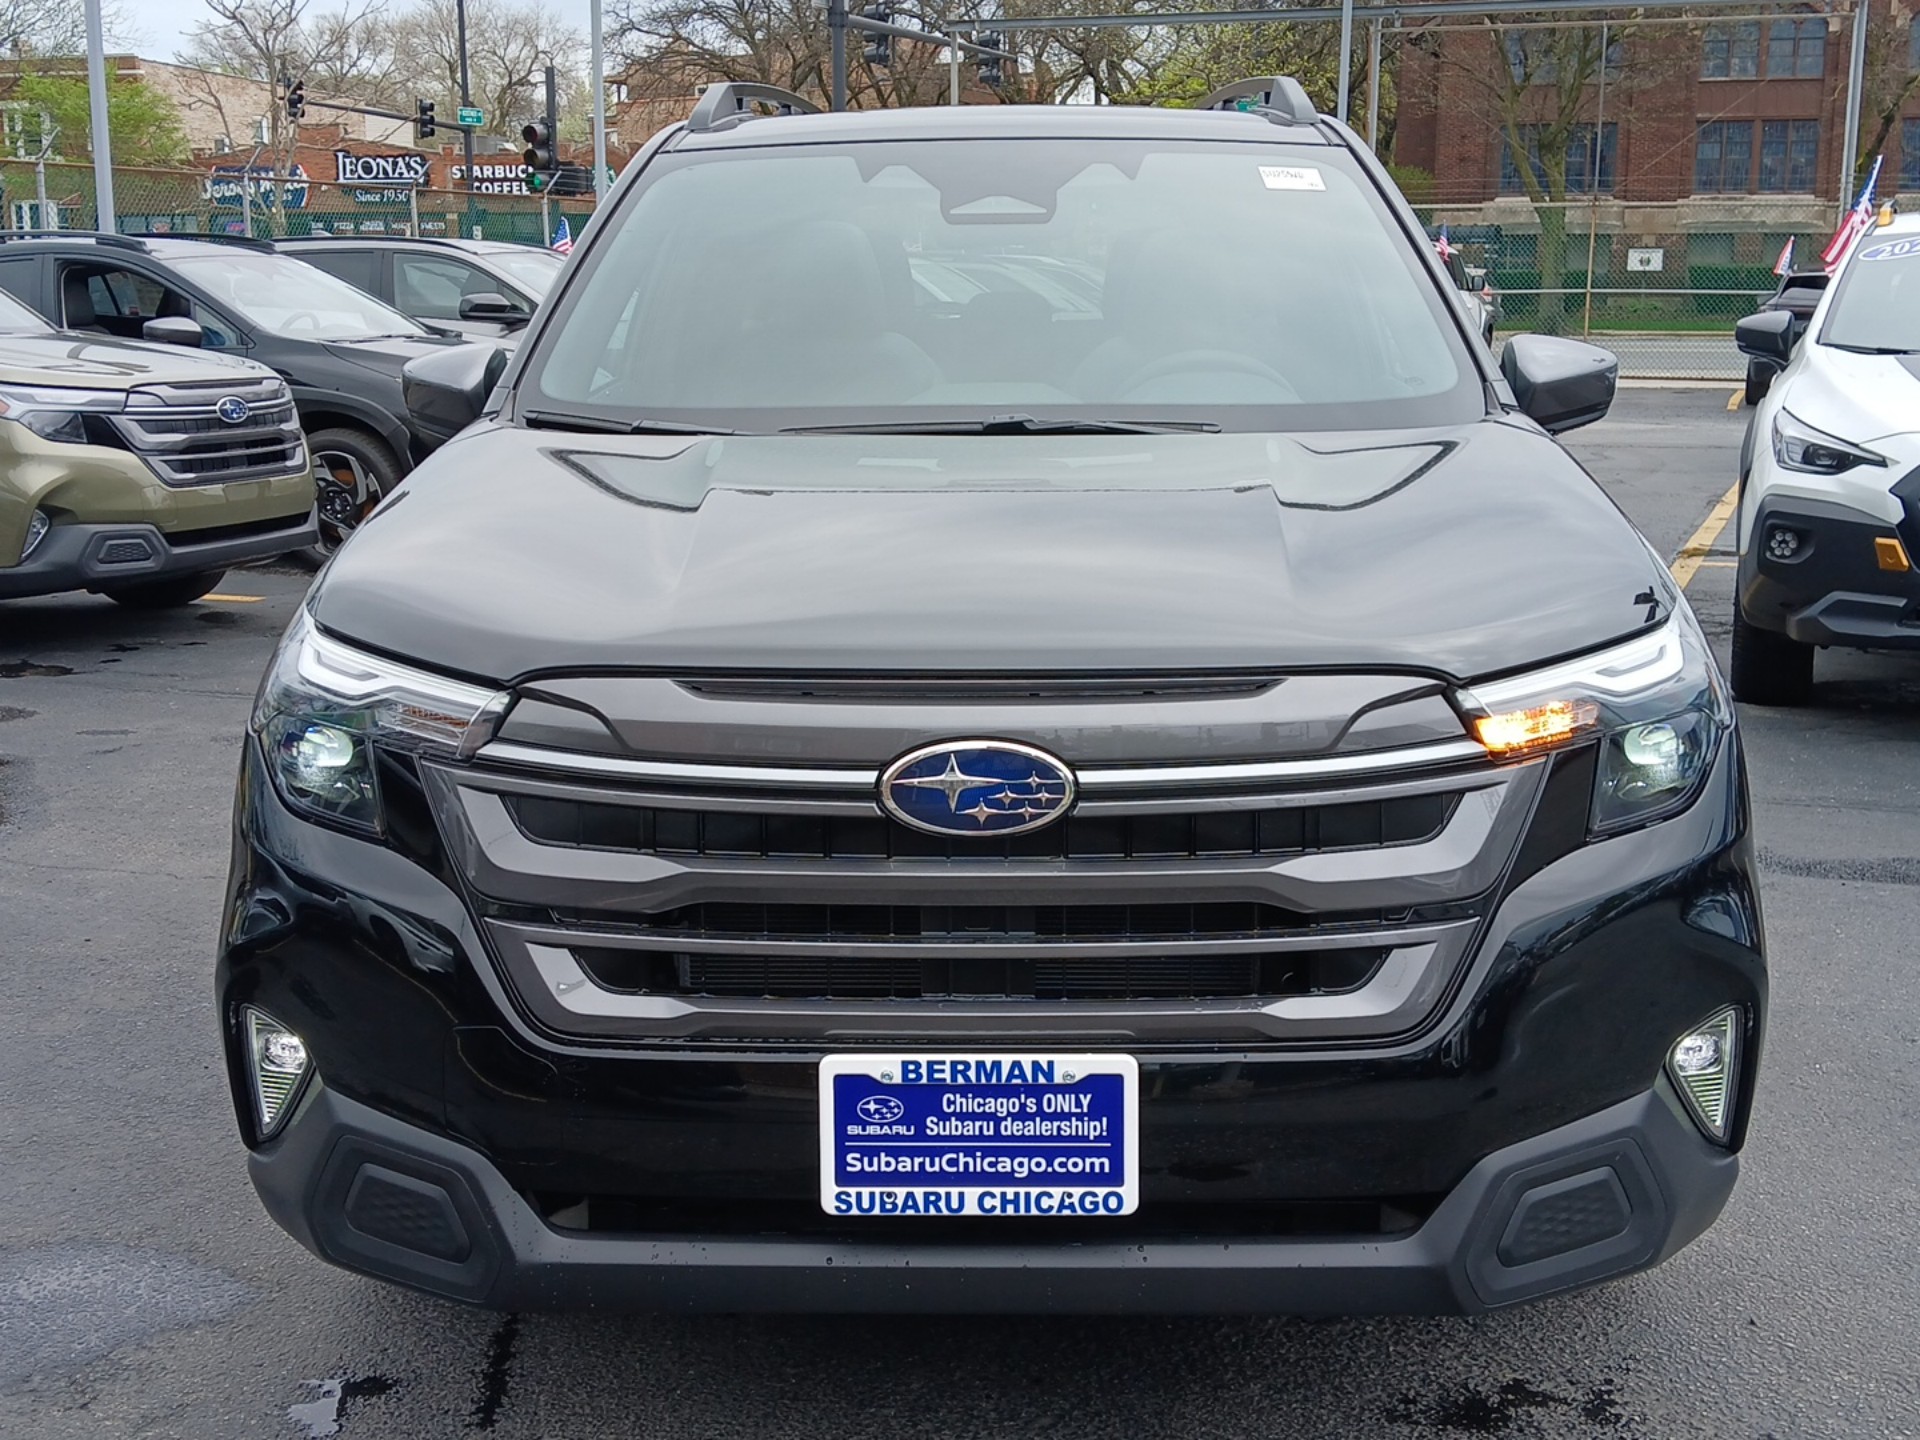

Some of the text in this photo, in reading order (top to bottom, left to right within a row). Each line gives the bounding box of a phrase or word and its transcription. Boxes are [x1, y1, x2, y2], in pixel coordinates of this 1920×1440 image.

[336, 152, 425, 183] LEONA'S
[452, 165, 534, 179] STARBUC
[355, 189, 381, 201] Since
[900, 1060, 1055, 1084] BERMAN
[942, 1093, 1092, 1117] Chicago's ONLY
[846, 1125, 915, 1136] SUBARU
[925, 1116, 1108, 1140] Subaru dealership!
[845, 1152, 1111, 1178] SubaruChicago.com
[834, 1191, 1125, 1215] SUBARU CHICAGO
